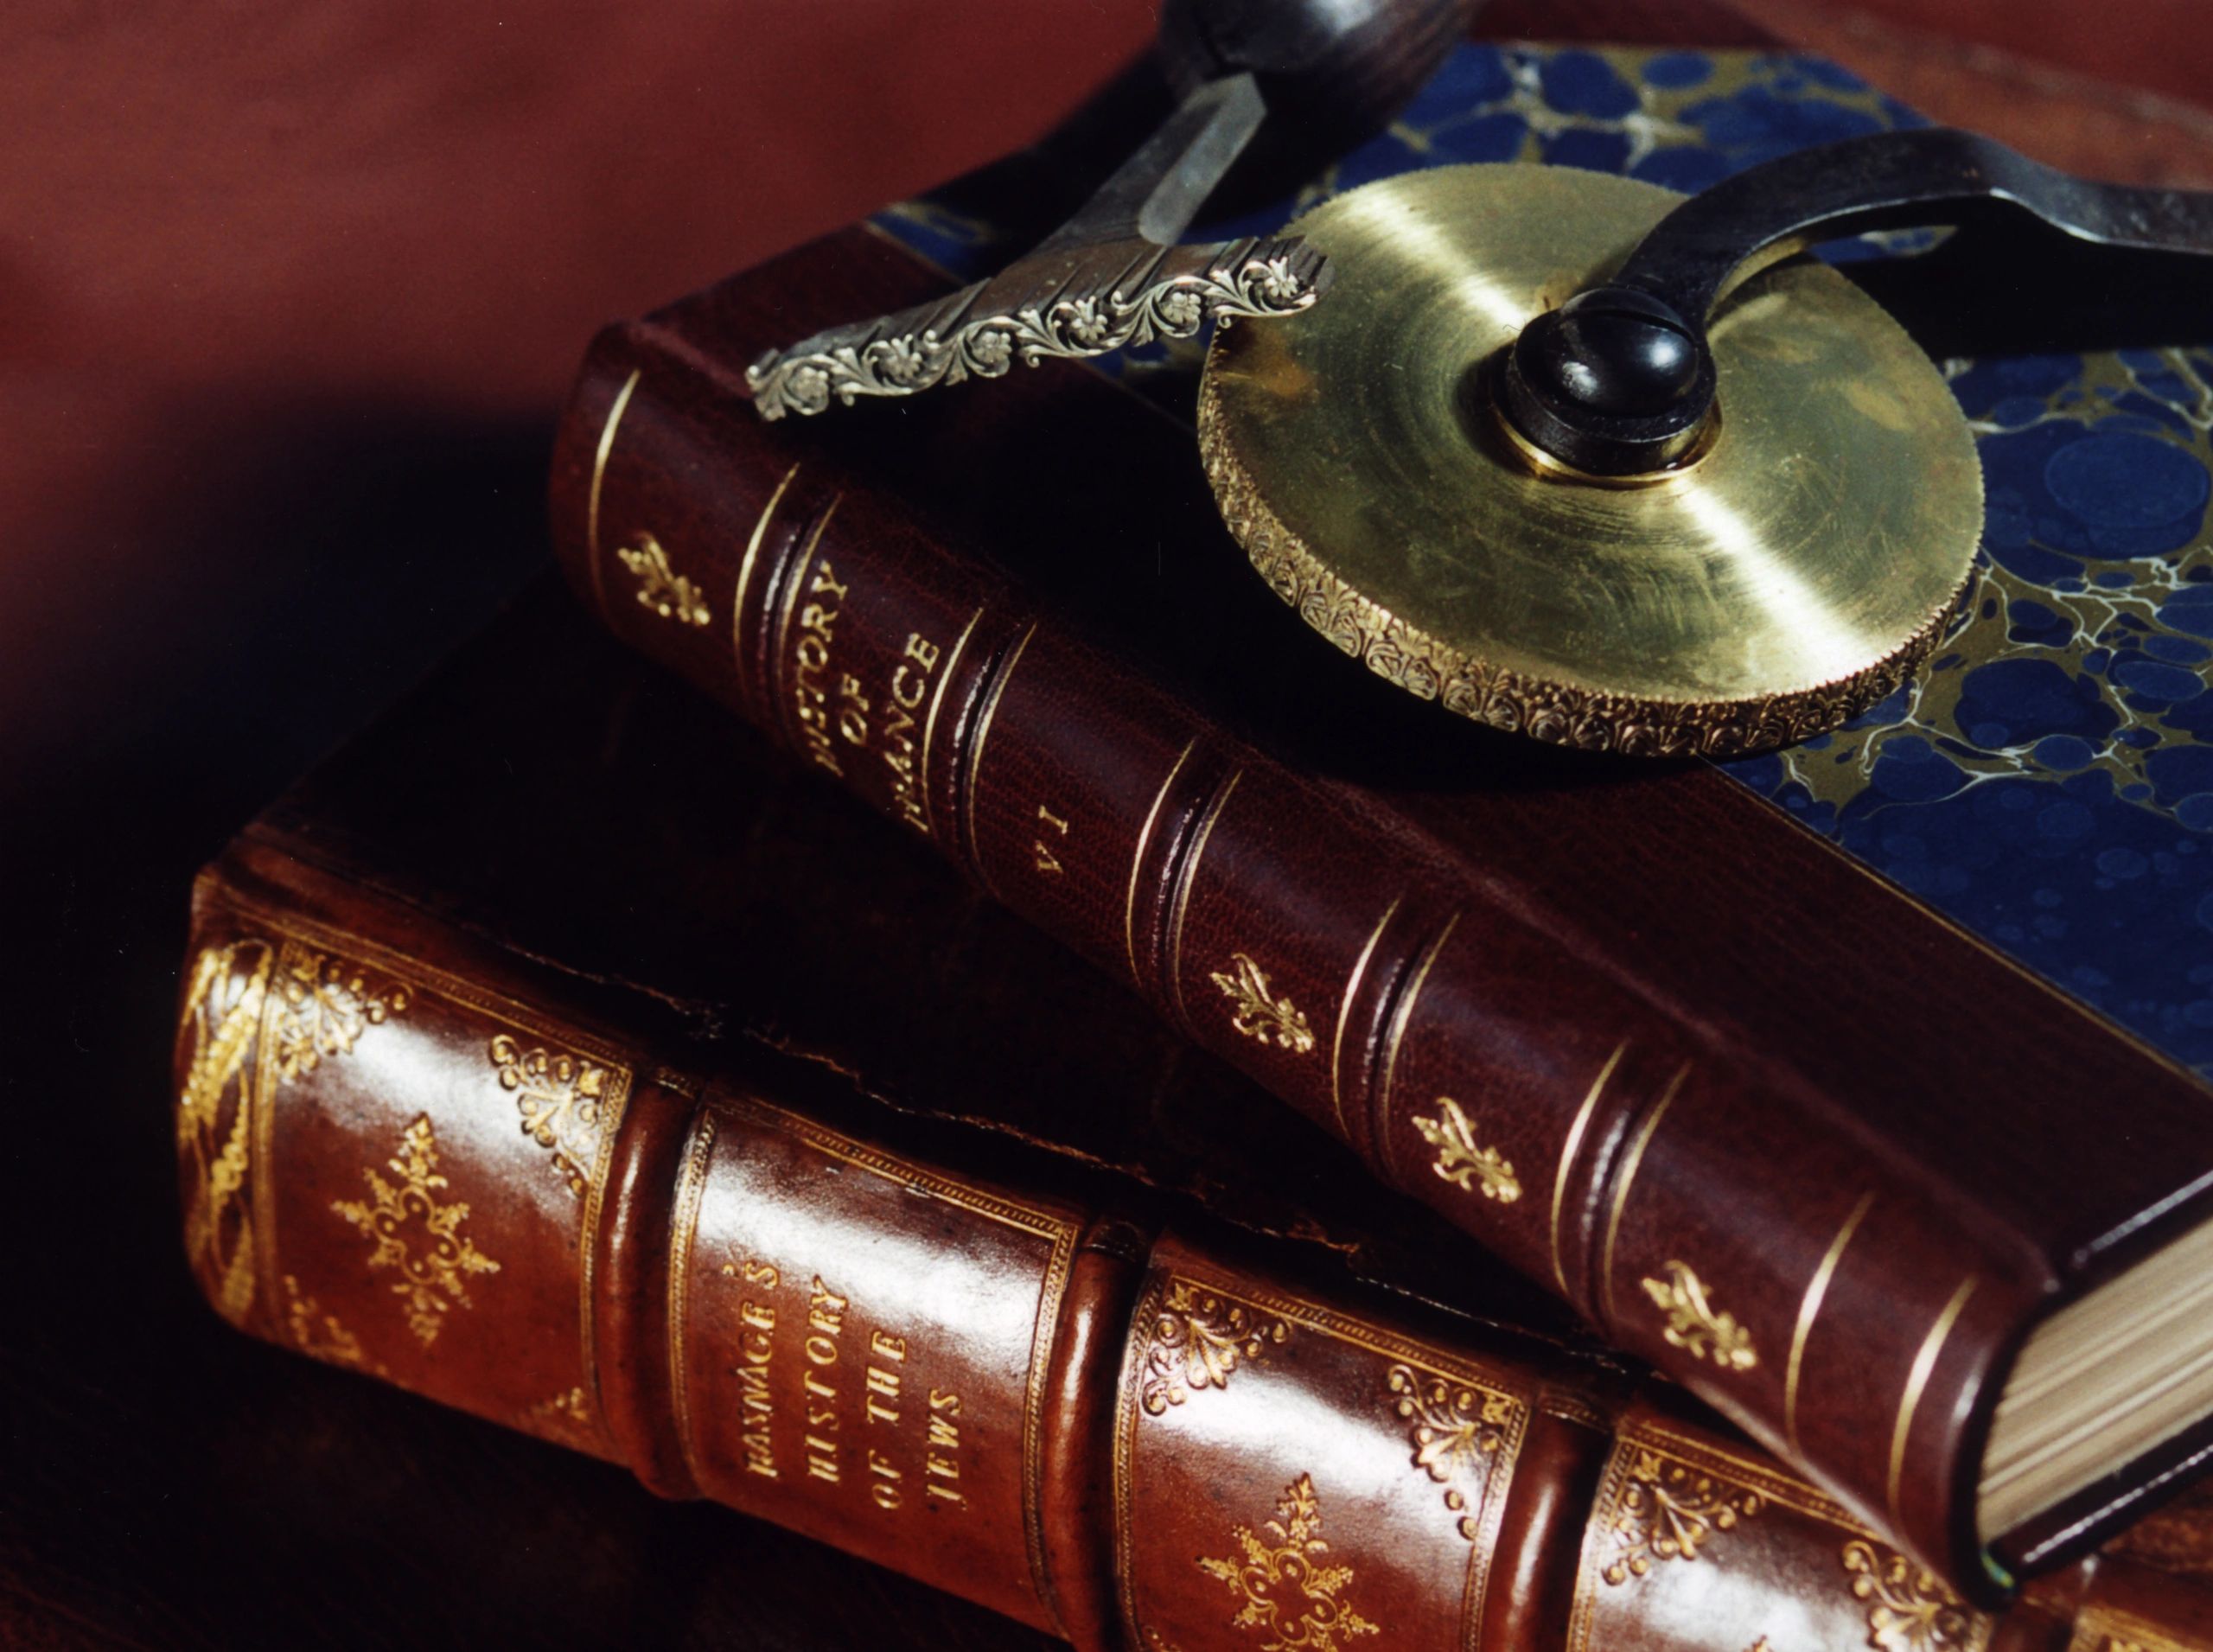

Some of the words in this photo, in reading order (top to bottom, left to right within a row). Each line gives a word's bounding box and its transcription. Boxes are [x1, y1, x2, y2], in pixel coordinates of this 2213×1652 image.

[840, 673, 870, 746] OF
[803, 1274, 850, 1483] HISTORY
[865, 1330, 908, 1426] THE
[868, 1449, 902, 1510] OF
[926, 1388, 968, 1511] JEWS
